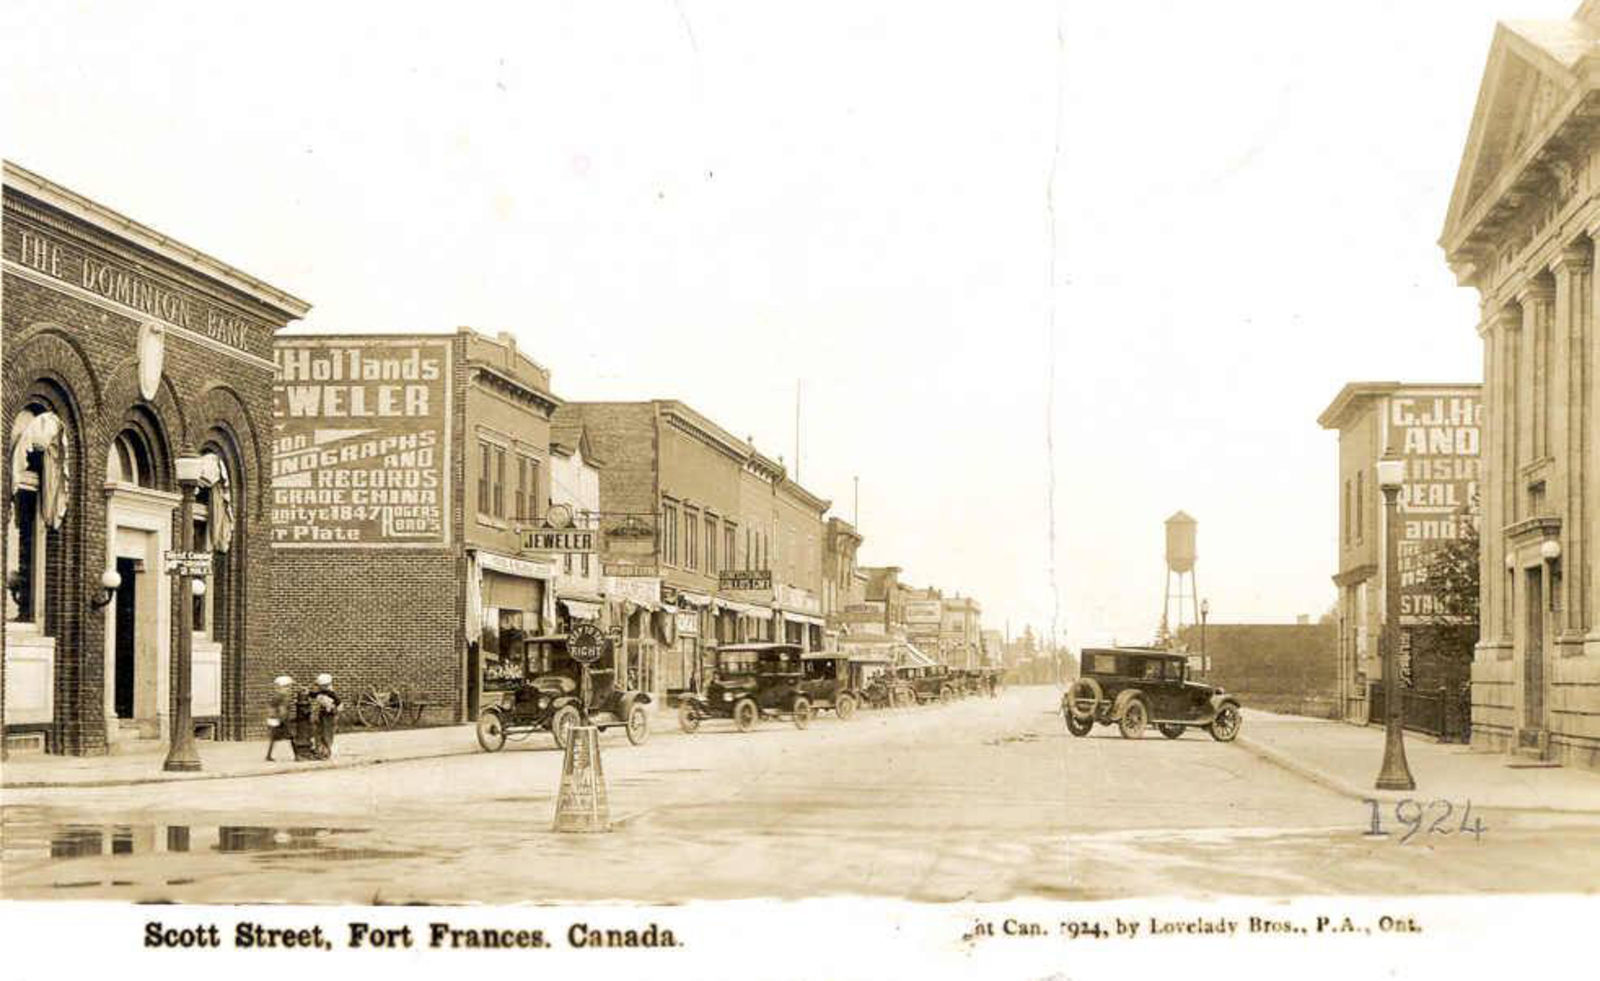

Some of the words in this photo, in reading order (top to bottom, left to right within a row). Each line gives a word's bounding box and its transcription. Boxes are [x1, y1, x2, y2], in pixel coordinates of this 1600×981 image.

[20, 231, 63, 278] THE
[82, 258, 190, 327] DOMINION
[207, 310, 250, 350] BANK
[318, 469, 437, 488] RECORDS
[275, 489, 346, 504] GRADE
[352, 489, 436, 504] CHINA
[294, 526, 360, 540] Plate
[525, 533, 592, 549] JEWELER
[1362, 797, 1488, 846] 1924
